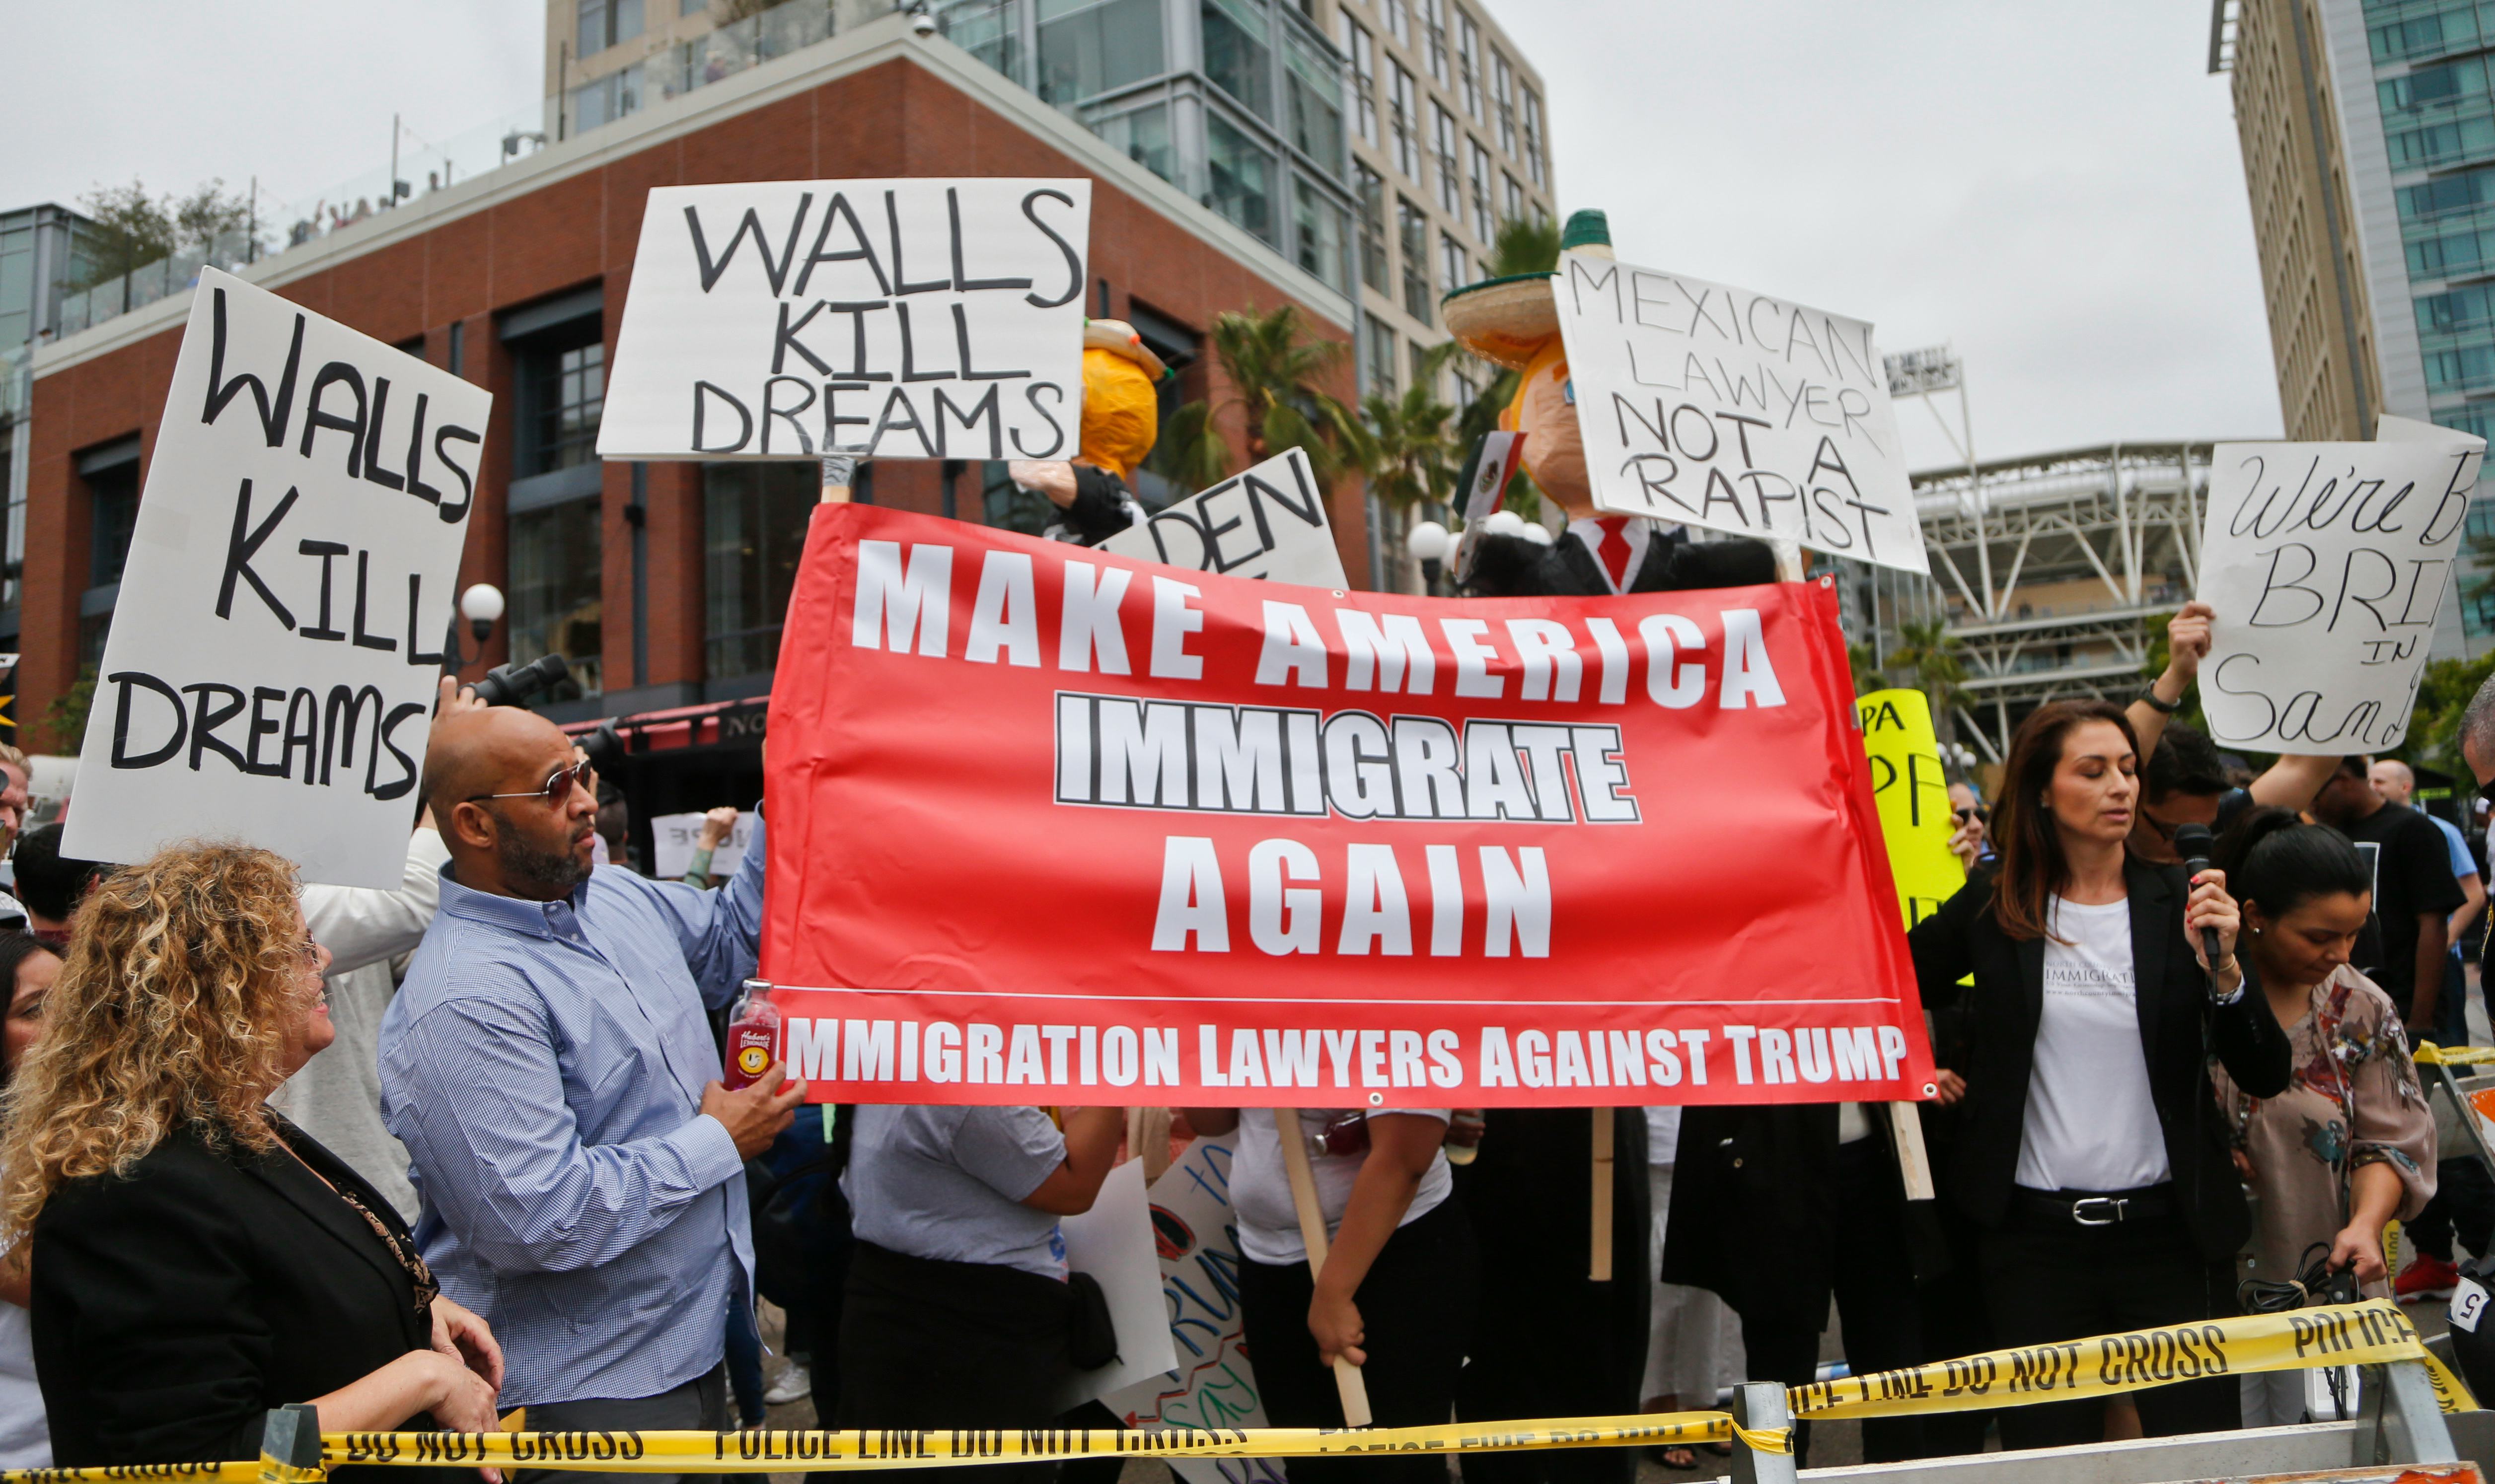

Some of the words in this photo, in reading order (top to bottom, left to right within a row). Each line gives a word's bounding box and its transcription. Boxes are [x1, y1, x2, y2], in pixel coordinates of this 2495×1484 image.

[684, 186, 1083, 308] WALLS
[771, 299, 1031, 382] KILL
[1571, 259, 1878, 389] MEXICAN
[201, 287, 481, 524] WALLS
[690, 375, 1064, 459] DREAMS
[1612, 391, 1772, 468] NOT
[1808, 435, 1861, 497] A
[1627, 340, 1886, 458] LAWYER
[1099, 451, 1323, 574] DEN
[1620, 453, 1891, 560] RAPIST
[2230, 454, 2415, 538] We're
[215, 478, 444, 665] KILL
[851, 538, 1204, 680] MAKE
[1254, 598, 1787, 709] AMERICA
[2249, 543, 2454, 633] BRI
[2360, 634, 2417, 665] IN
[108, 670, 426, 801] DREAMS
[1053, 689, 1642, 824] IMMIGRATE
[1150, 835, 1551, 958] AGAIN
[776, 1016, 1180, 1087] MMIGRATION
[1198, 1024, 1464, 1088] LAWYERS
[1479, 1026, 1710, 1088] AGAINST
[1723, 1024, 1907, 1085] TRUMP
[1943, 1356, 1996, 1396] DO
[2009, 1342, 2084, 1393] NOT
[2099, 1324, 2228, 1385] CROSS
[2287, 1307, 2417, 1358] POLICE
[2460, 1293, 2480, 1320] 5
[858, 1429, 937, 1459] LINE
